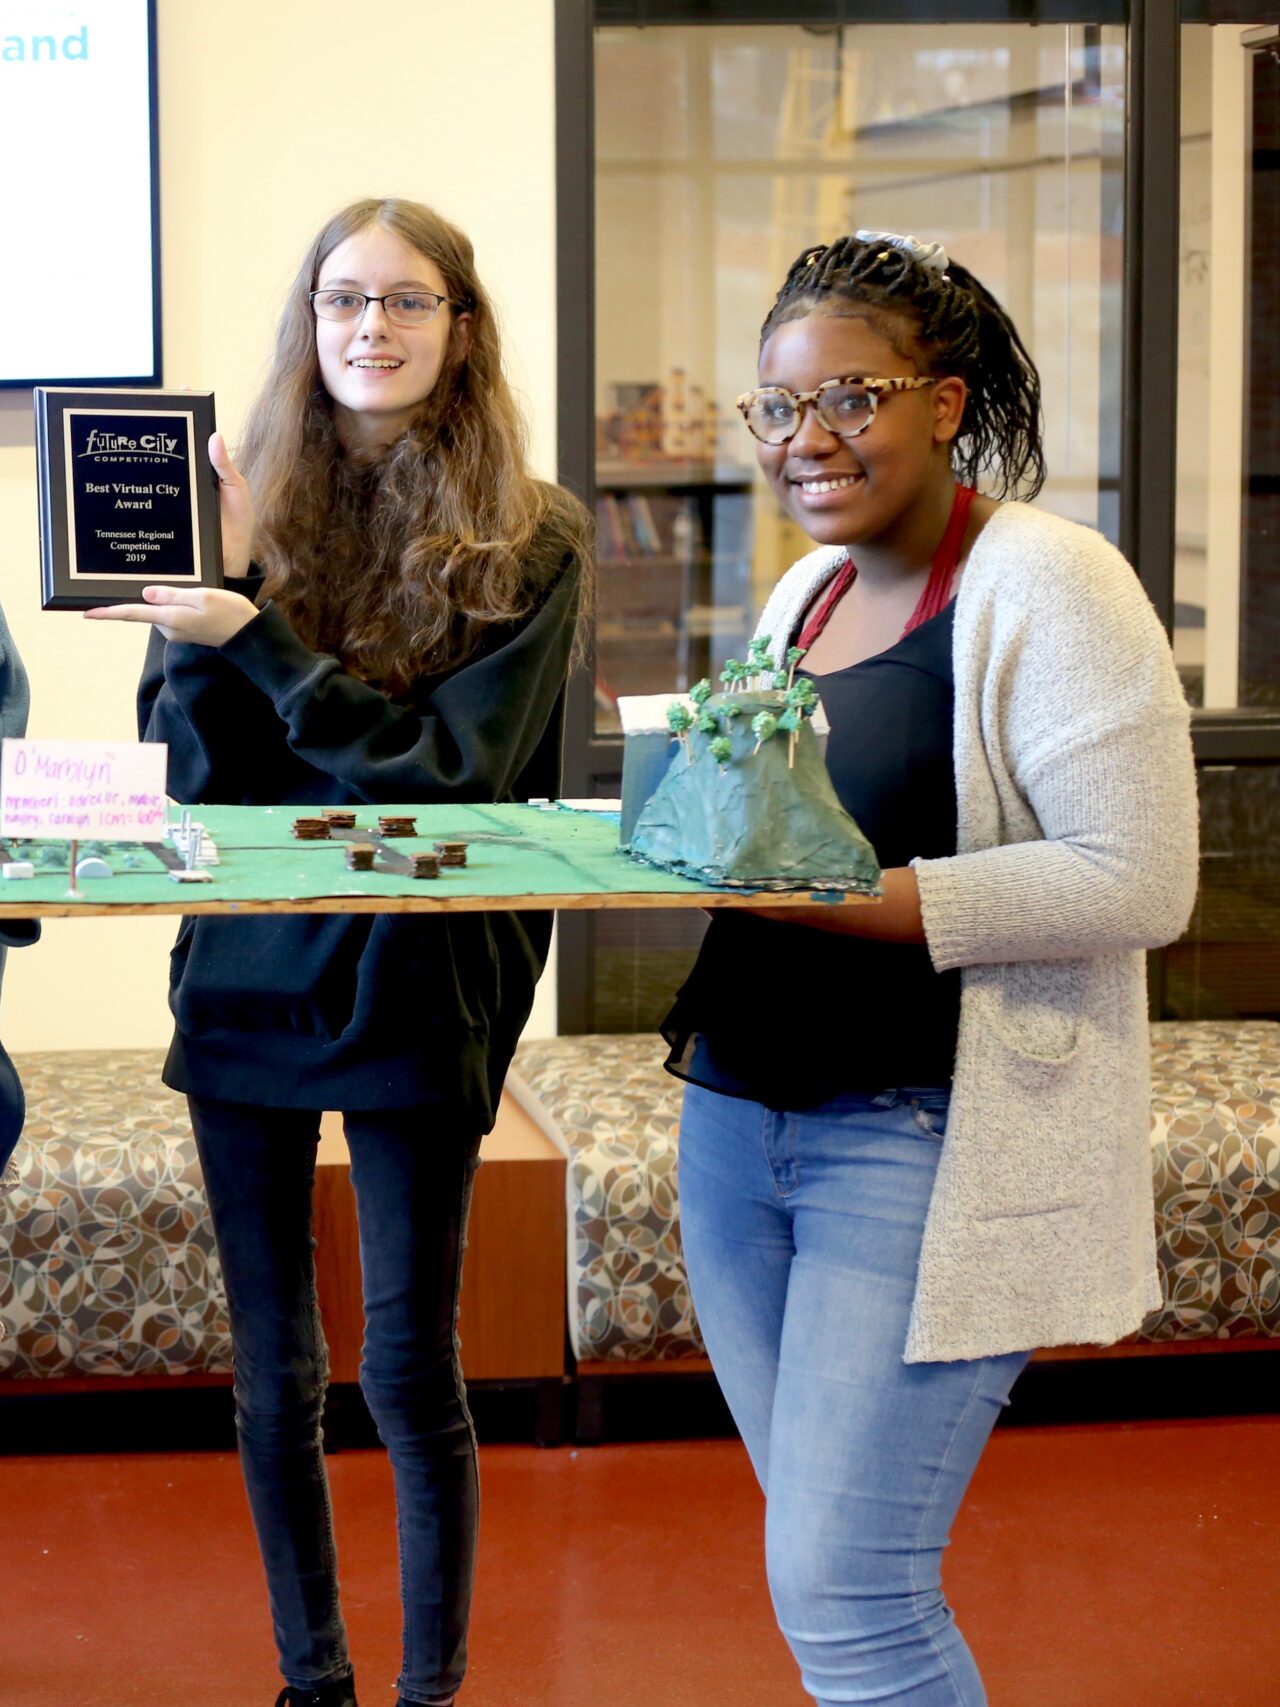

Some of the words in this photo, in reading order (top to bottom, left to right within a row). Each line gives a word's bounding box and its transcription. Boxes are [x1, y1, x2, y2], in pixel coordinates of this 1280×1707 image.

[94, 455, 169, 463] COMPETITION
[85, 482, 110, 493] Best
[112, 484, 153, 494] Virtual
[155, 484, 180, 496] City
[114, 499, 152, 509] Award
[95, 529, 136, 539] Tennessee
[138, 530, 174, 541] Regional
[110, 541, 160, 551] Competition
[125, 553, 146, 562] 2019
